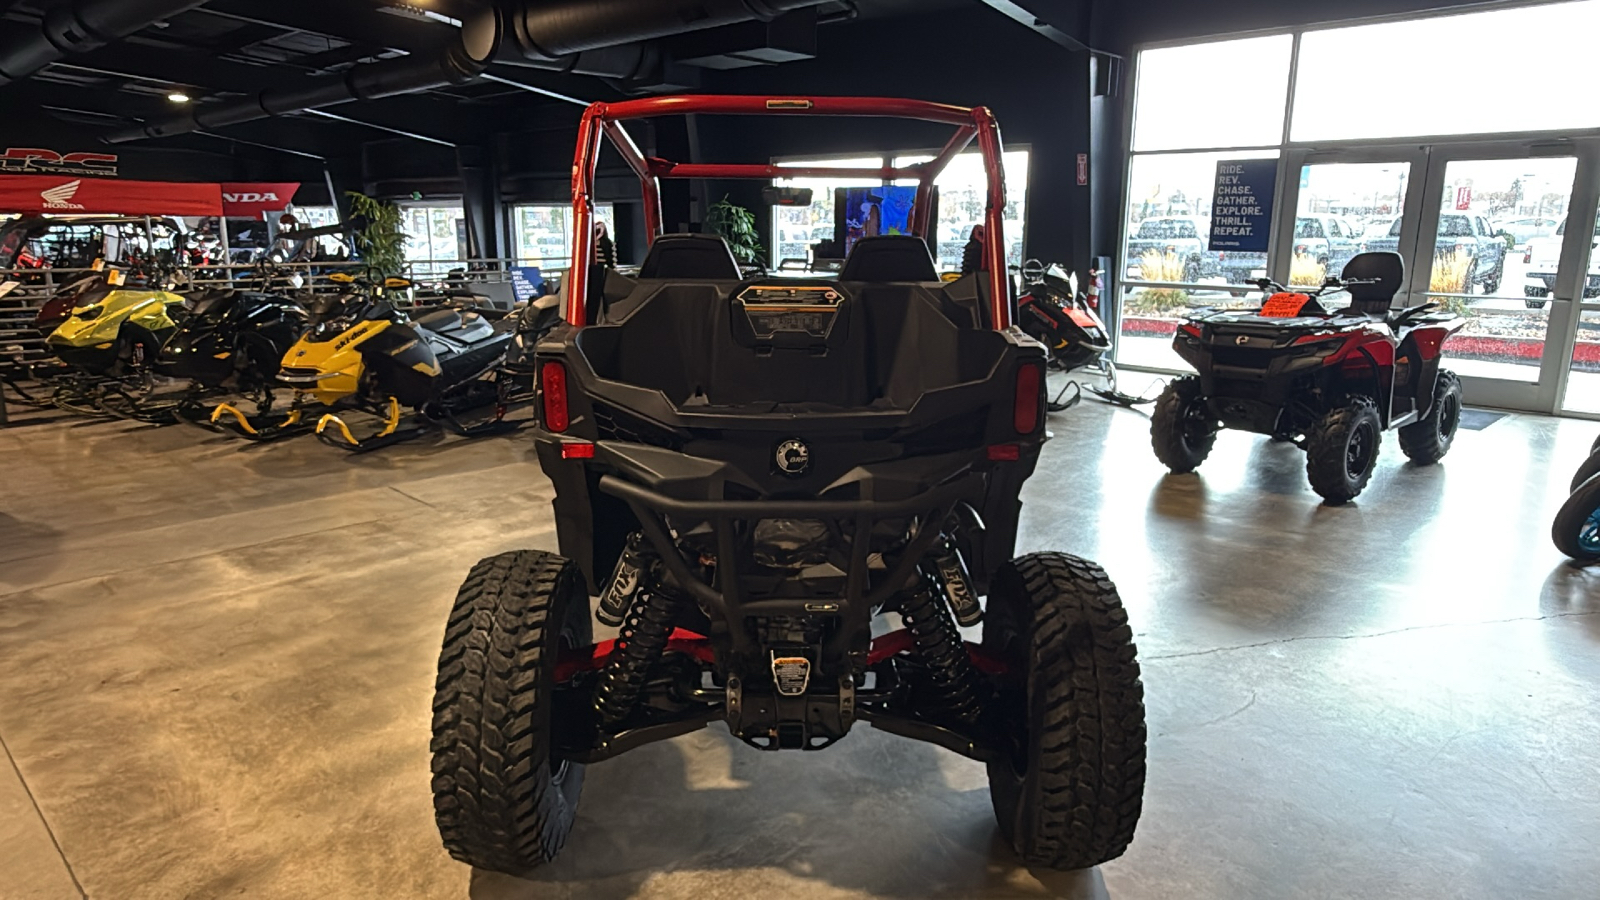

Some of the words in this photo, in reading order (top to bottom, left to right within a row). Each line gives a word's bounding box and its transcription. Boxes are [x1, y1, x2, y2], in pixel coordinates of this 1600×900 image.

[1220, 165, 1245, 174] RIDE.
[1219, 176, 1240, 184] REV.
[1217, 186, 1253, 194] CHASE.
[1217, 197, 1258, 205] GATHER.
[42, 202, 85, 210] HONDA
[1216, 207, 1263, 215] EXPLORE.
[1215, 217, 1252, 226] THRILL.
[1213, 227, 1254, 236] REPEAT.
[608, 561, 639, 609] FOX
[943, 567, 973, 610] FOX
